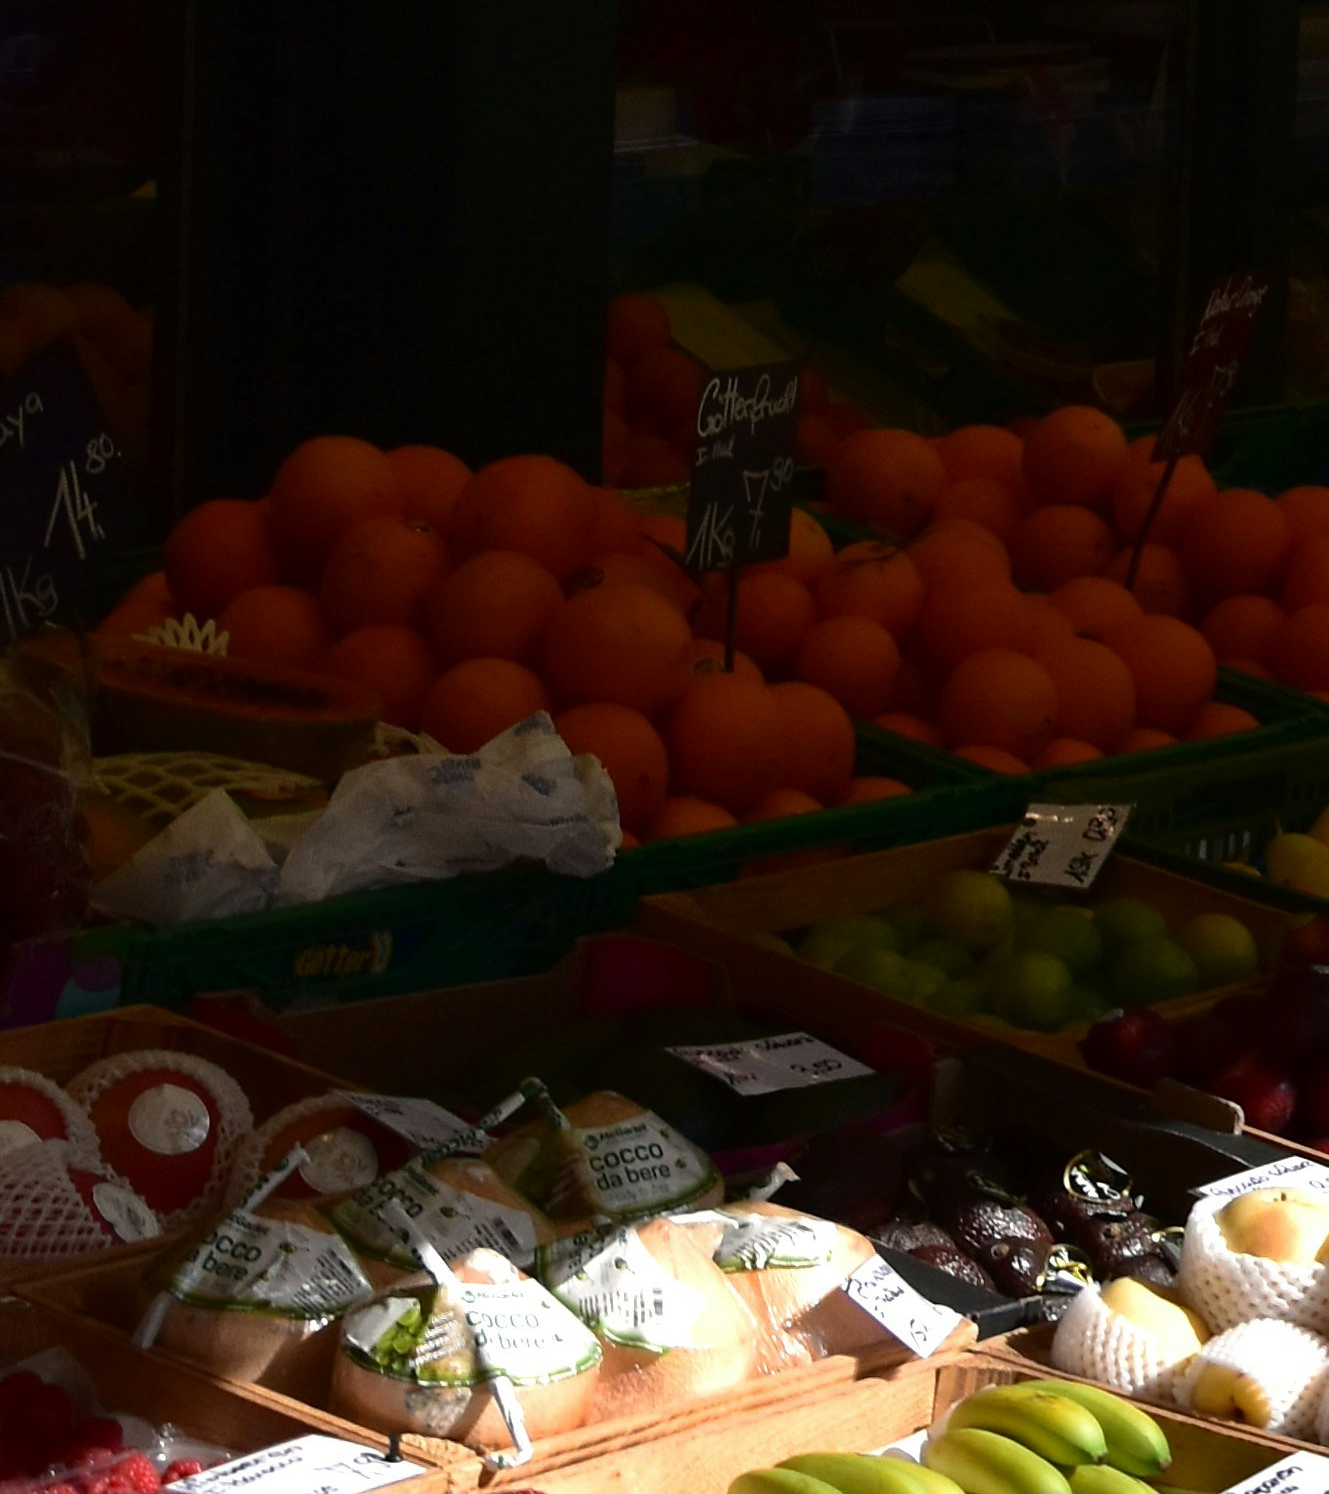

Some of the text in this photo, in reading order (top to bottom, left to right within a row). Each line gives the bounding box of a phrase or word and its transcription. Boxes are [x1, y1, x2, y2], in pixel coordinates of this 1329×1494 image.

[589, 1143, 664, 1172] cocco
[596, 1172, 623, 1191] da
[625, 1163, 671, 1183] bere
